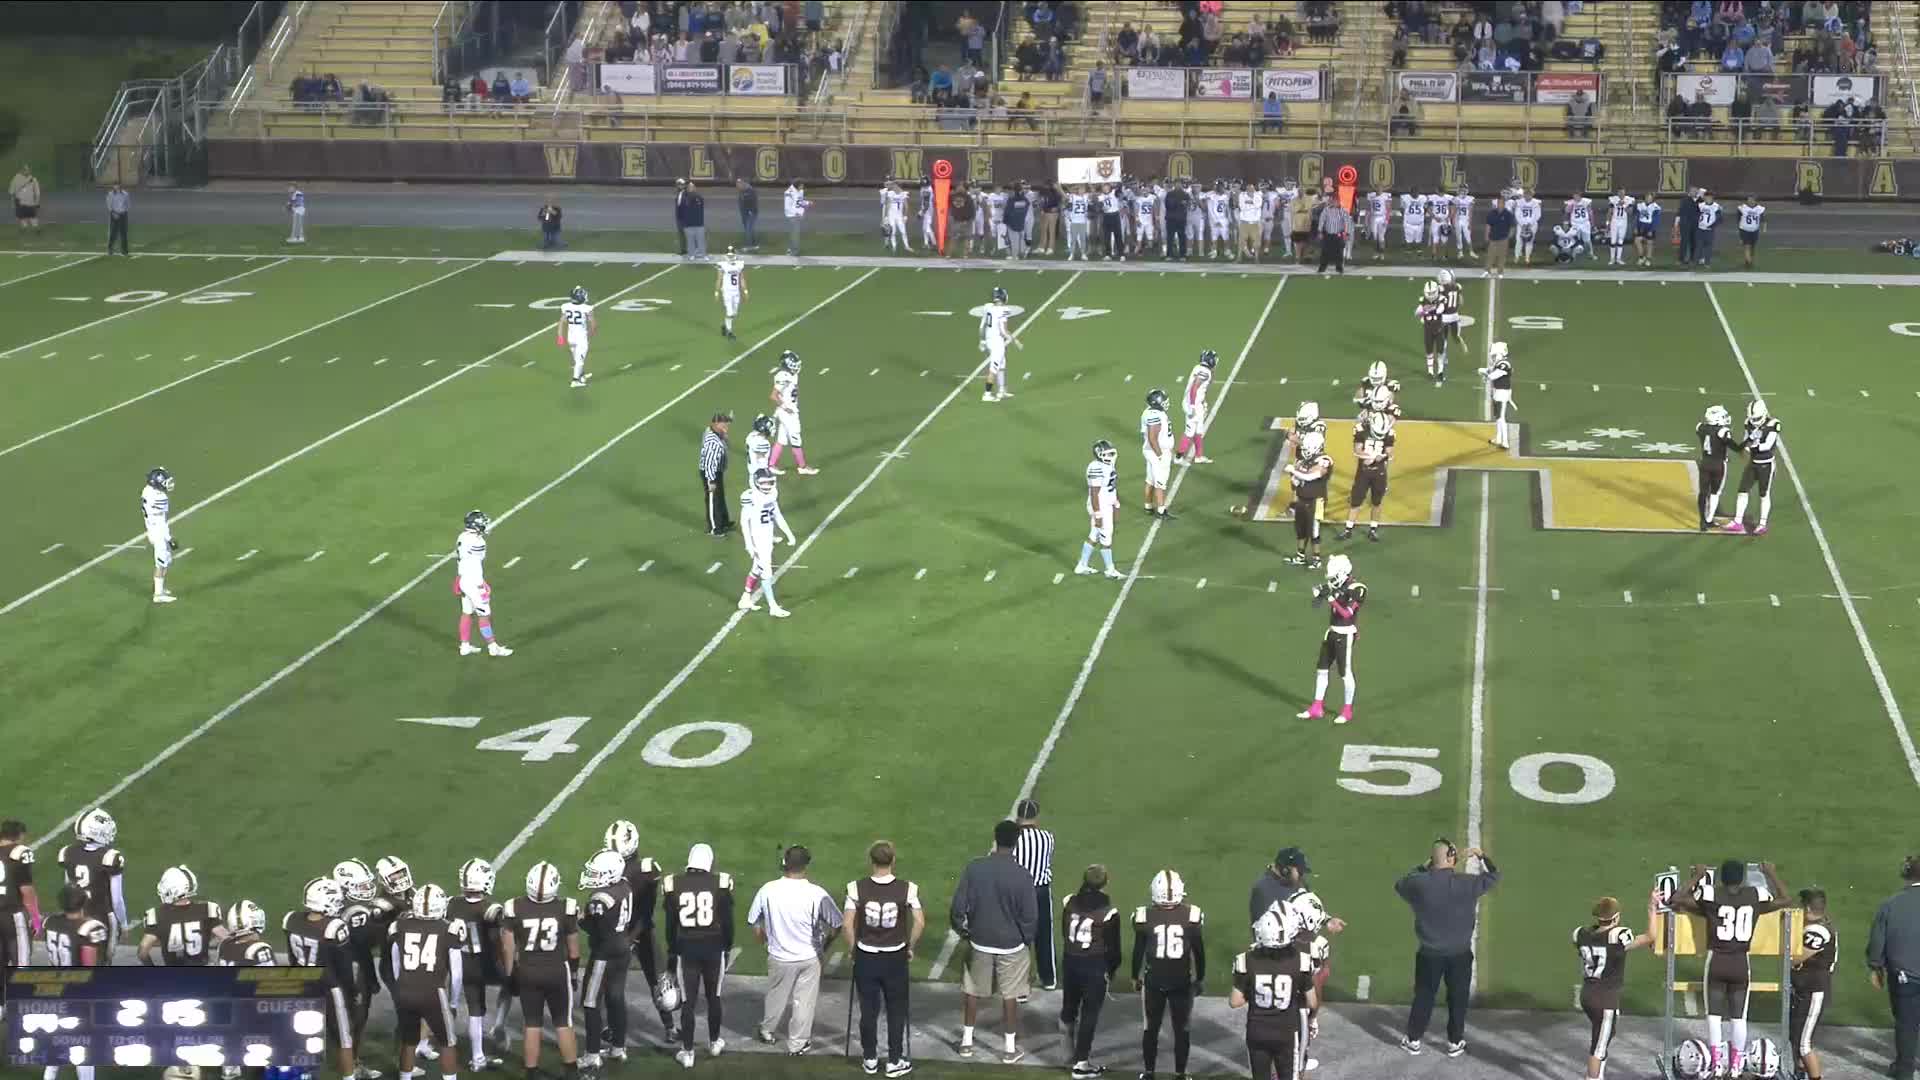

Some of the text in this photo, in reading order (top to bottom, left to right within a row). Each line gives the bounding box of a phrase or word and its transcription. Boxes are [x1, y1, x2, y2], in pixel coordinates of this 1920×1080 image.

[544, 144, 993, 184] WELCOME
[1300, 153, 1688, 194] GOLDEN
[1408, 204, 1422, 215] 65
[566, 310, 583, 325] 22
[1336, 744, 1617, 804] 50
[678, 891, 714, 928] 28
[1716, 905, 1754, 942] 30
[46, 930, 73, 966] 56
[167, 921, 203, 956] 45
[522, 917, 559, 952] 73
[1068, 912, 1095, 949] 14
[1153, 924, 1185, 960] 16
[403, 932, 438, 972] 54
[1255, 974, 1293, 1010] 59
